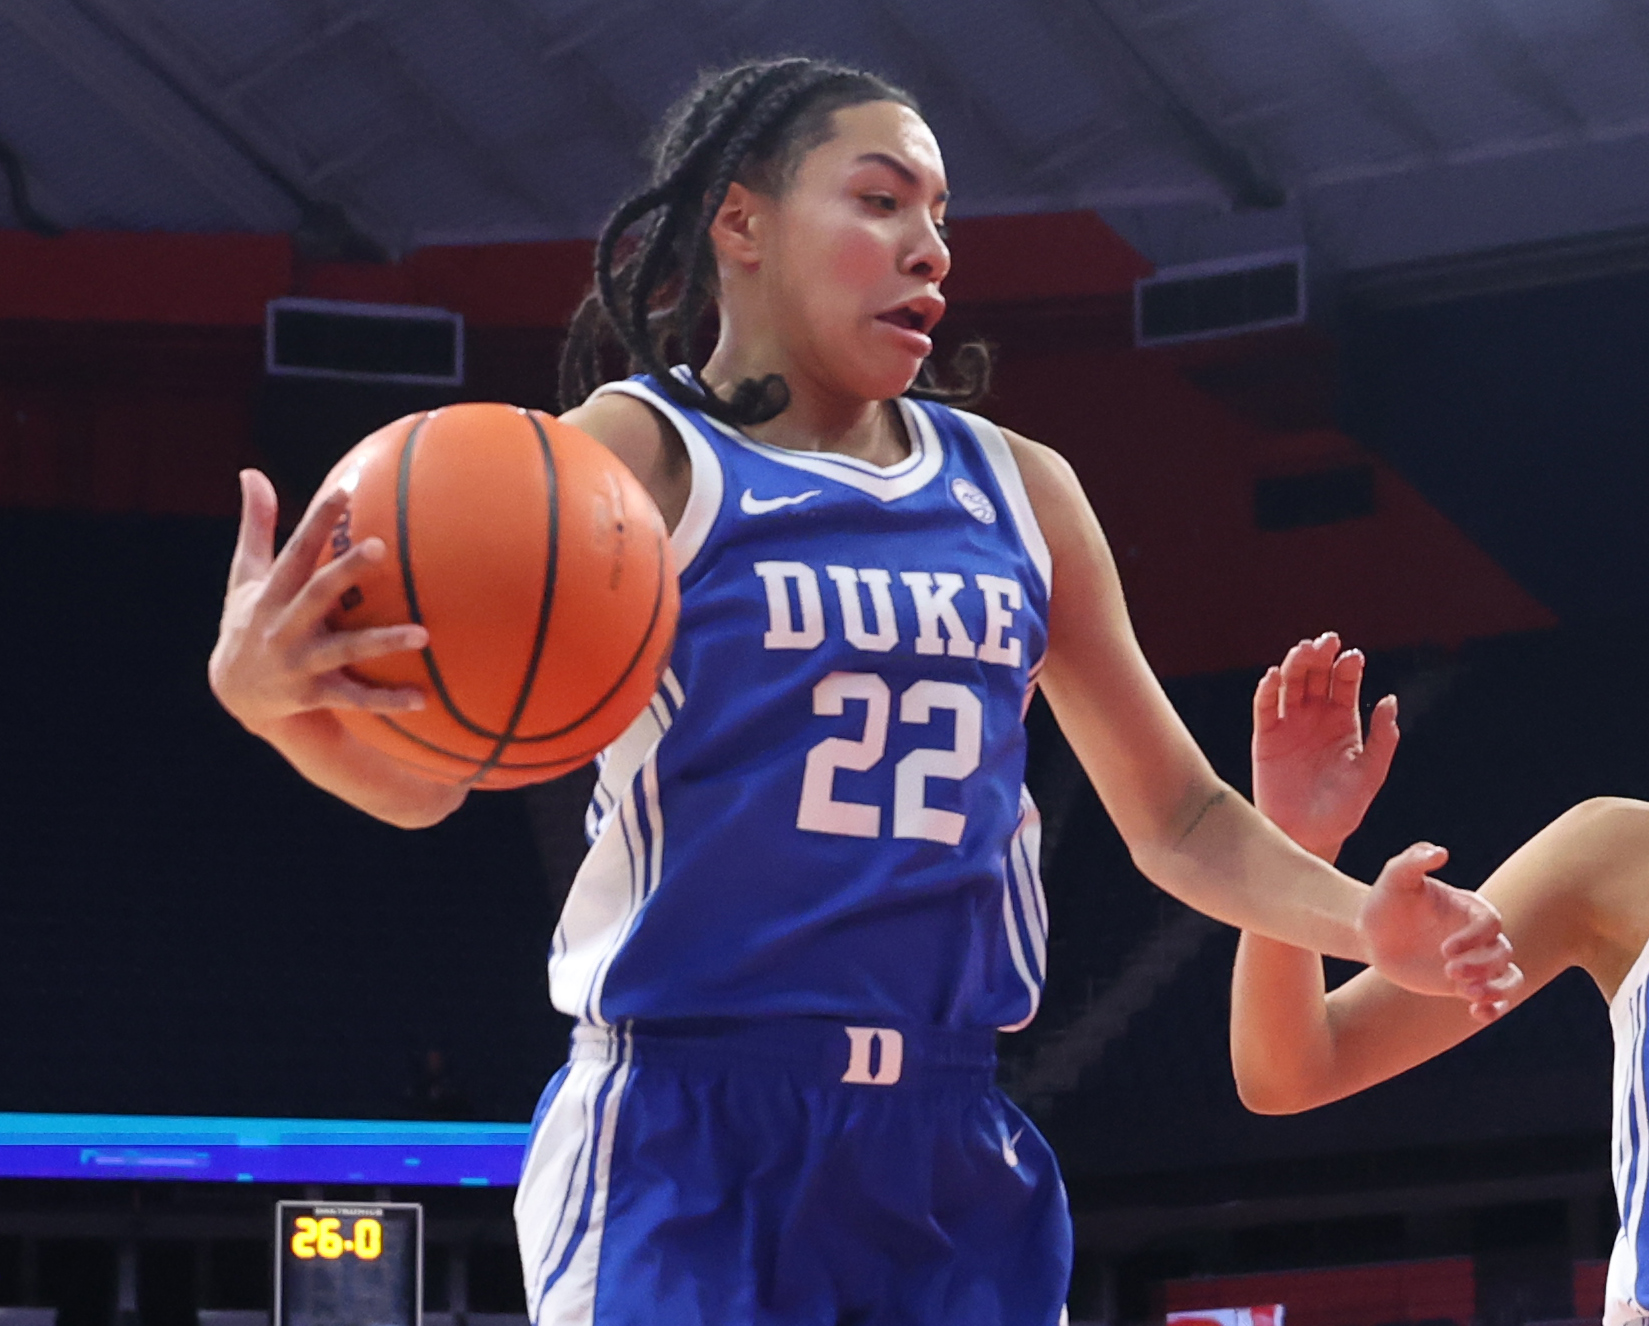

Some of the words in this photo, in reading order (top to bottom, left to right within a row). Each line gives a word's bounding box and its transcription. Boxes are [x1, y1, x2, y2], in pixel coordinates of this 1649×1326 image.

[753, 560, 1022, 668] DUKE
[796, 671, 982, 846] 22
[840, 1026, 904, 1086] D
[290, 1216, 383, 1261] 26.0
